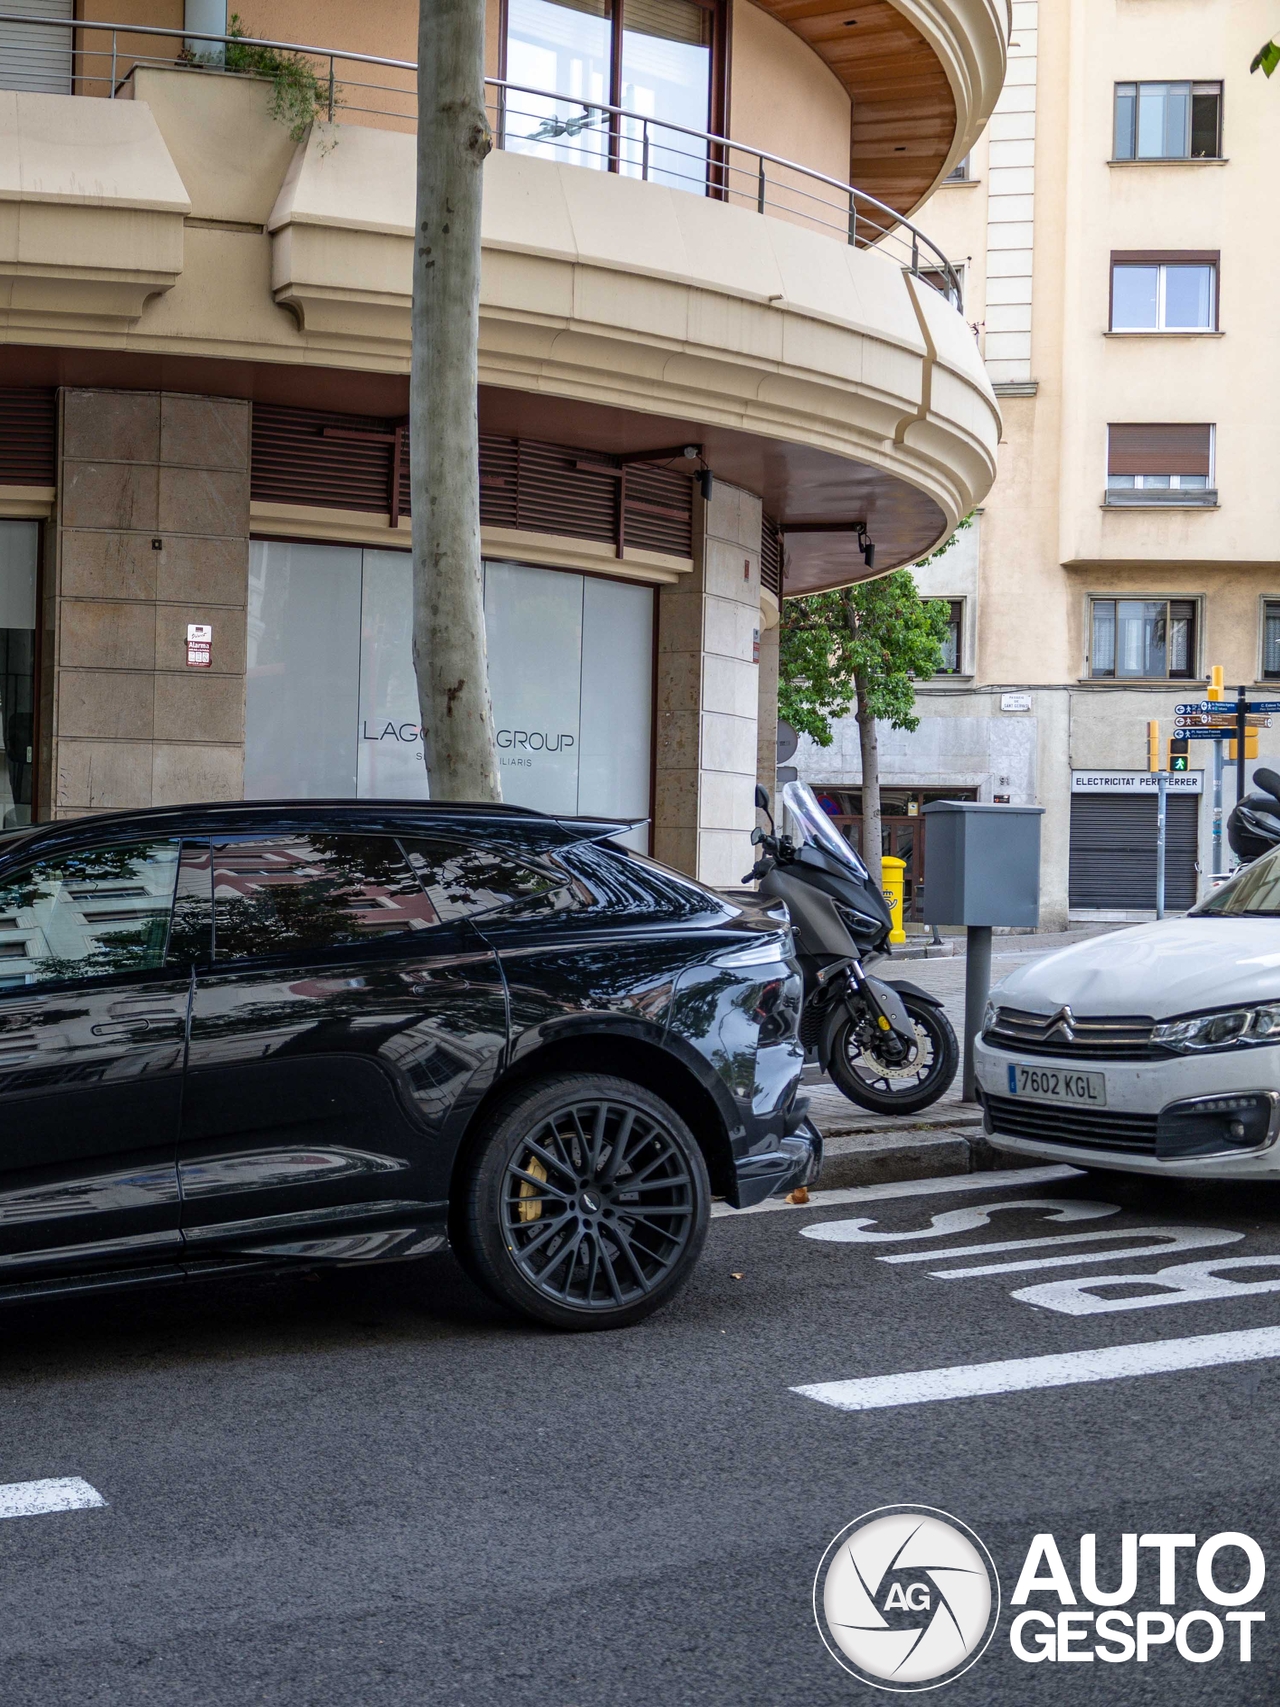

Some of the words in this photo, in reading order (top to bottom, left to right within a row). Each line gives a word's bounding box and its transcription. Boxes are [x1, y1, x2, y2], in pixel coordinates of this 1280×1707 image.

[496, 729, 575, 752] GROUP
[1076, 777, 1135, 786] ELECTRICITAT
[1021, 1069, 1060, 1095] 7602
[1064, 1074, 1098, 1100] KGL
